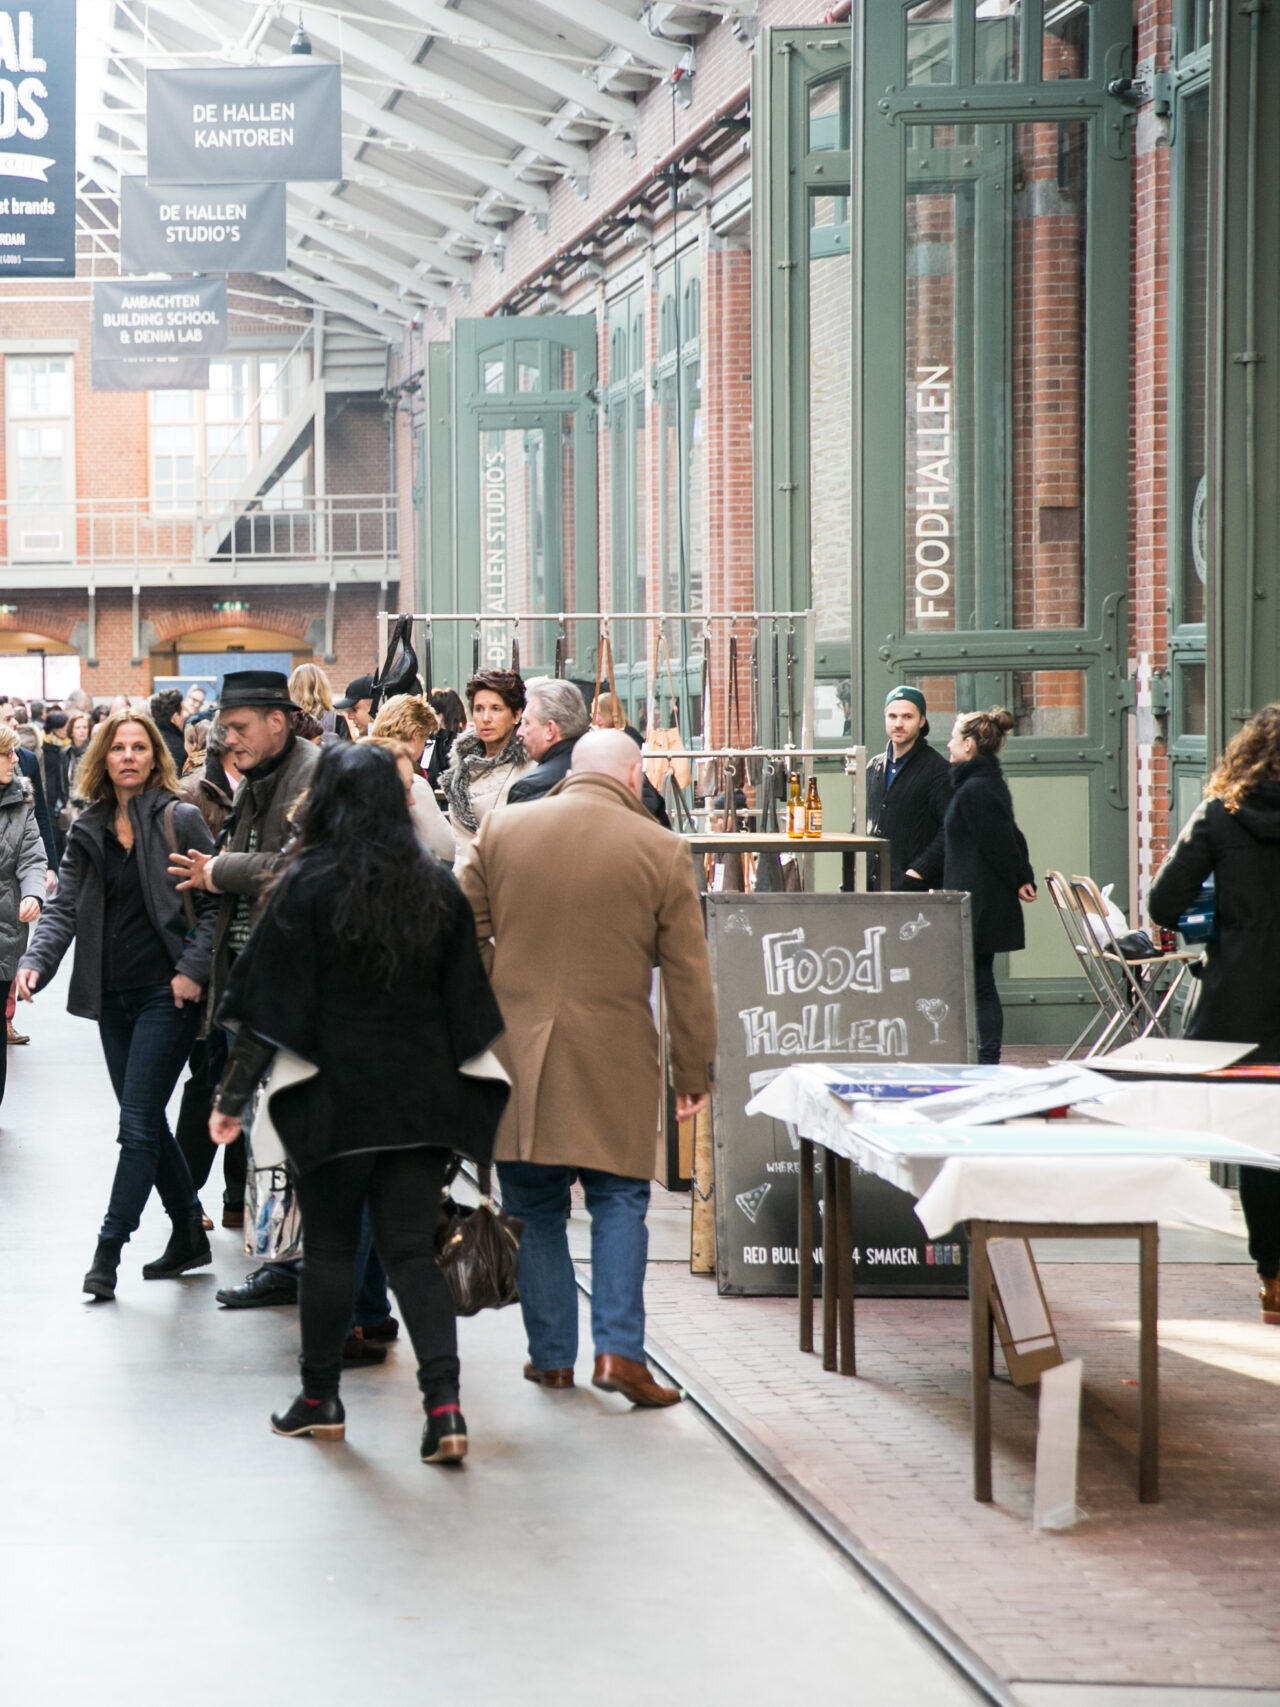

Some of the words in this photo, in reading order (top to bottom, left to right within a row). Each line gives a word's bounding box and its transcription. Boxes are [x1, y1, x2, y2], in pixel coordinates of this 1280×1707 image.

[193, 104, 217, 123] DE
[223, 102, 295, 122] HALLEN
[194, 128, 294, 148] KANTOREN
[11, 197, 56, 216] brands
[159, 204, 180, 221] DE
[185, 204, 247, 220] HALLEN
[166, 226, 240, 243] STUDIO'S
[121, 294, 200, 309] AMBACHTEN
[102, 312, 164, 327] BUILDING
[166, 311, 220, 326] SCHOOL
[120, 330, 131, 344] &
[134, 329, 175, 343] DENIM
[178, 328, 203, 343] LAB
[486, 451, 506, 542] STUDIO'S
[915, 365, 951, 617] FOODHALLEN
[487, 633, 506, 661] DE
[743, 1246, 767, 1265] RED
[772, 1246, 800, 1265] BULL
[851, 1247, 861, 1265] 4
[866, 1247, 920, 1265] SMAKEN.
